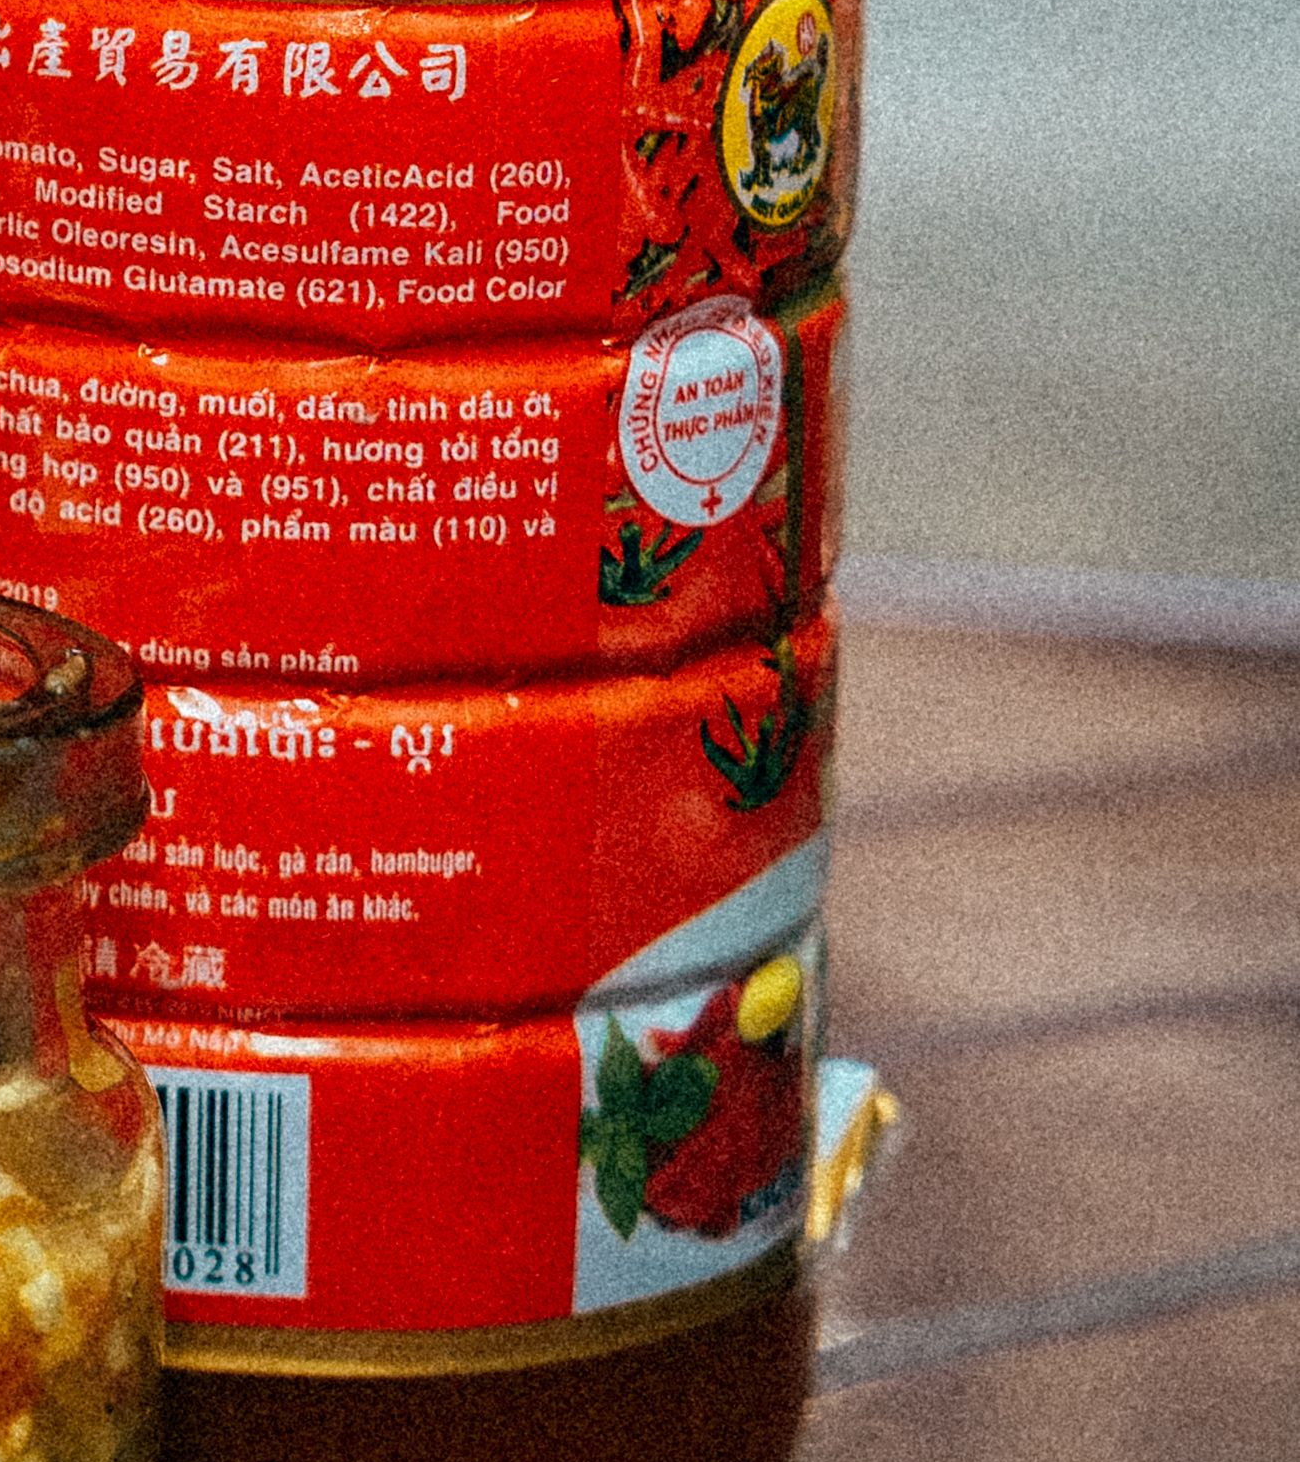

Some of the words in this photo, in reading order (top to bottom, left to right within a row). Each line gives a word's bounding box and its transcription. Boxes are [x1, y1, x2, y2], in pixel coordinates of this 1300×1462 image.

[99, 147, 196, 184] Sugar,
[212, 156, 283, 189] Salt,
[299, 161, 474, 189] AceticAcid
[489, 159, 571, 194] (260),
[35, 177, 163, 215] Modified
[203, 194, 307, 225] Starch
[349, 200, 457, 233] (1422),
[497, 198, 570, 225] Food
[52, 218, 206, 261] Oleoresin,
[220, 235, 410, 266] Acesulfame
[424, 240, 483, 266] Kali
[495, 235, 570, 270] (950)
[123, 264, 286, 301] Glutamate
[296, 276, 385, 310] (621),
[398, 278, 474, 303] Food
[486, 275, 567, 302] Color
[80, 378, 186, 417] đường,
[198, 387, 285, 424] muối,
[674, 382, 698, 405] AN
[55, 413, 111, 445] bảo
[124, 423, 202, 455] quản
[217, 429, 306, 466] (211),
[323, 436, 424, 468] hương
[440, 431, 478, 461] tỏi
[491, 425, 560, 464] tổng
[113, 461, 190, 500] (950)
[207, 470, 243, 498] và
[260, 474, 349, 508] (951),
[366, 471, 436, 502] chất
[452, 470, 517, 502] điều
[59, 498, 122, 527] acid
[137, 503, 223, 541] (260),
[240, 508, 330, 544] phẩm
[349, 516, 416, 542] màu
[432, 515, 508, 549] (110)
[522, 509, 557, 537] và
[139, 638, 211, 671] dùng
[220, 640, 270, 670] sản
[280, 642, 359, 674] phẩm
[371, 847, 482, 880] hambuger,
[173, 1246, 255, 1286] 028
